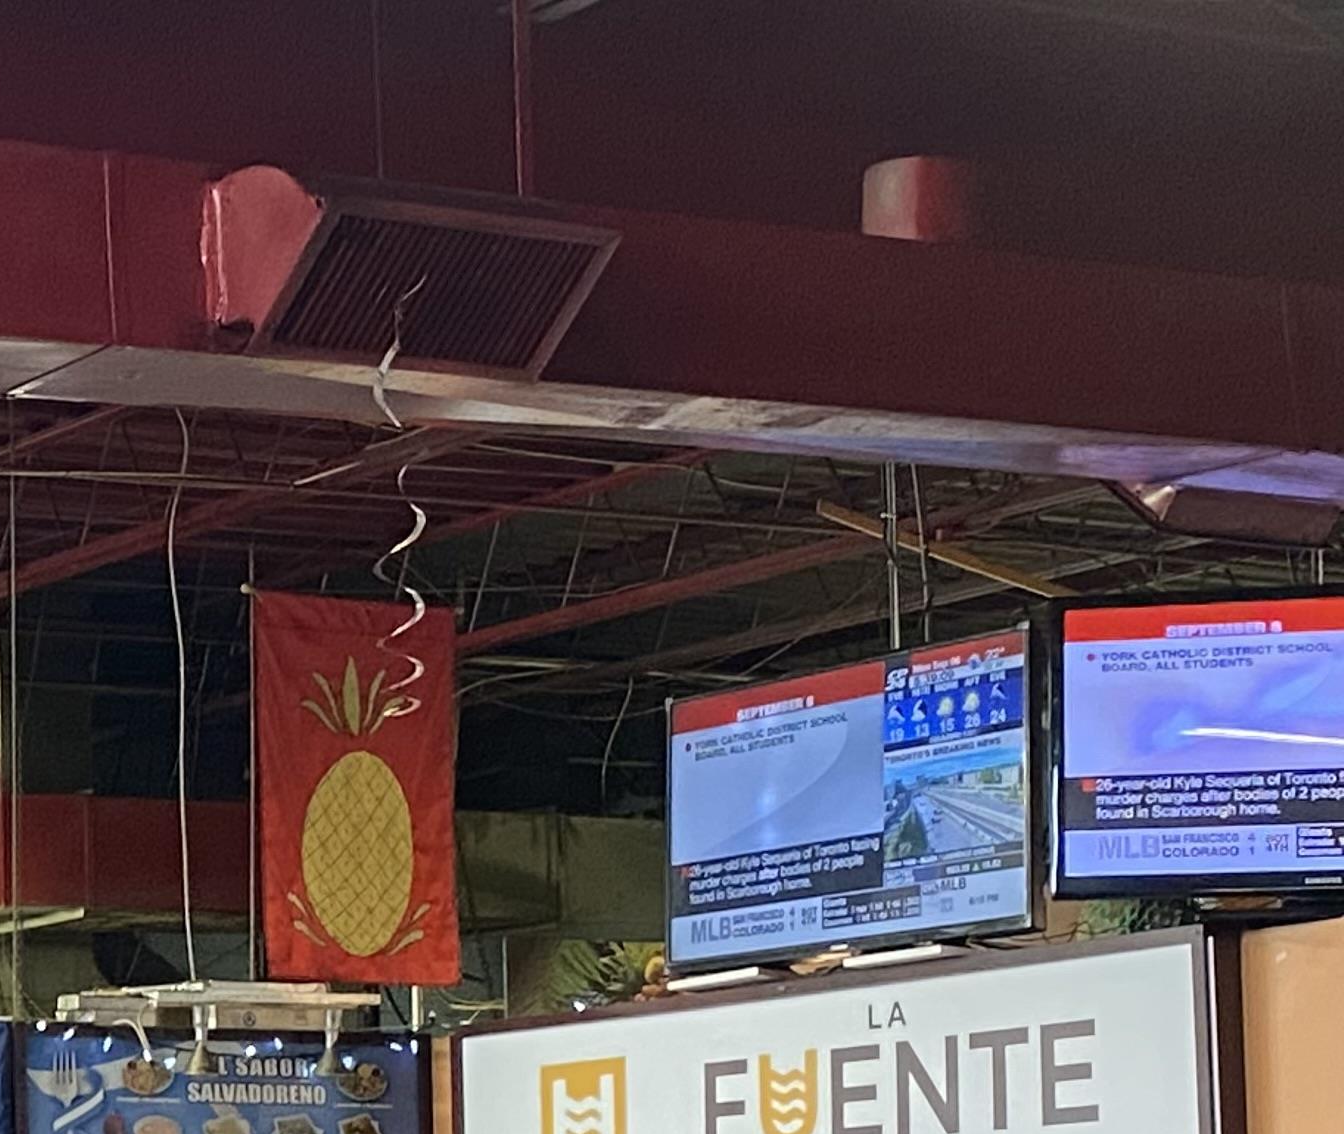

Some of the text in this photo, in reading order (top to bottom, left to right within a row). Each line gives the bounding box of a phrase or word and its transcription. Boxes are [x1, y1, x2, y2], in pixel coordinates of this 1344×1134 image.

[1166, 621, 1266, 639] SEPTEMBER
[1101, 642, 1333, 662] YORK CATHOLIC DISTRICT SCHOOL
[1102, 657, 1253, 673] BOARD, ALL STUDENTS
[721, 730, 765, 747] CATHOLIC
[767, 720, 807, 737] DISTRICT
[811, 712, 848, 728] SCHOOL
[748, 735, 794, 750] STUDENTS
[1174, 777, 1202, 792] Kyle
[1267, 774, 1281, 785] of
[1284, 771, 1336, 785] Toronto
[1096, 787, 1344, 806] murder charges after bodies of 2 peop
[1096, 803, 1280, 819] found in Scarborough home.
[815, 843, 849, 857] Toronto
[1097, 836, 1160, 860] MLB
[1162, 845, 1239, 858] COLORADO
[832, 854, 864, 871] people
[939, 877, 967, 890] MLB
[691, 916, 732, 944] MLB
[733, 922, 784, 937] COLORADO
[868, 1001, 907, 1030] LA
[236, 1057, 310, 1077] SABOR
